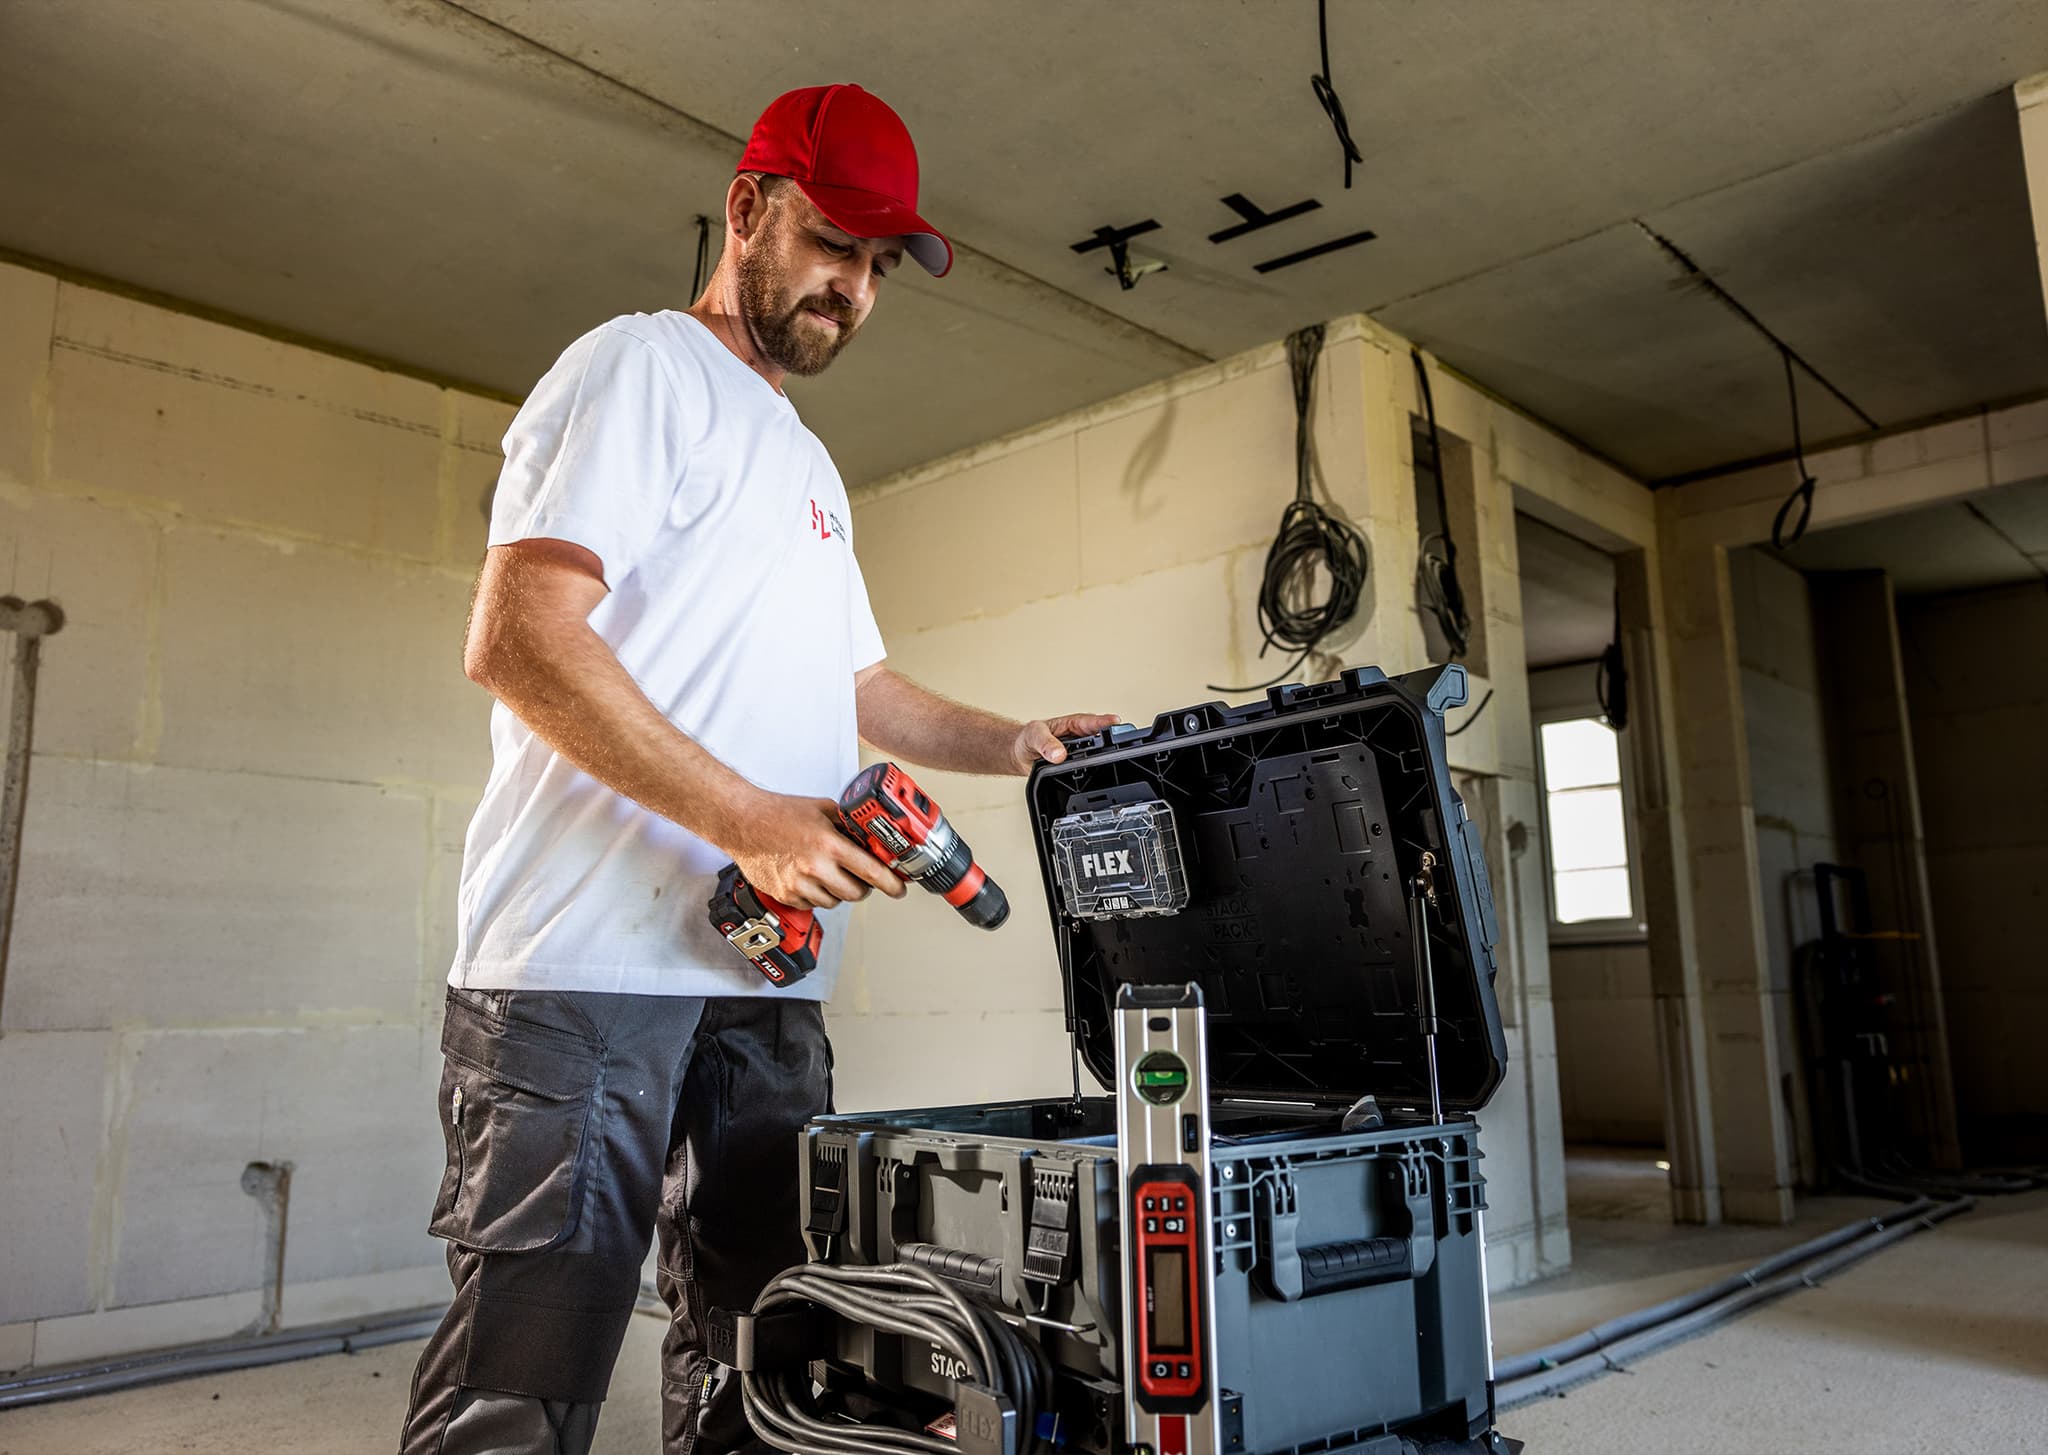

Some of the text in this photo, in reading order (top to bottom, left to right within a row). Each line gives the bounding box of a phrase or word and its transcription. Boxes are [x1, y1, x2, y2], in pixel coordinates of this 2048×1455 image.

[1081, 848, 1135, 878] FLEX
[1207, 896, 1250, 917] STACK
[1216, 920, 1251, 939] PACK
[761, 961, 781, 978] FLEX
[931, 1352, 973, 1380] STAC
[961, 1407, 997, 1444] FLEX
